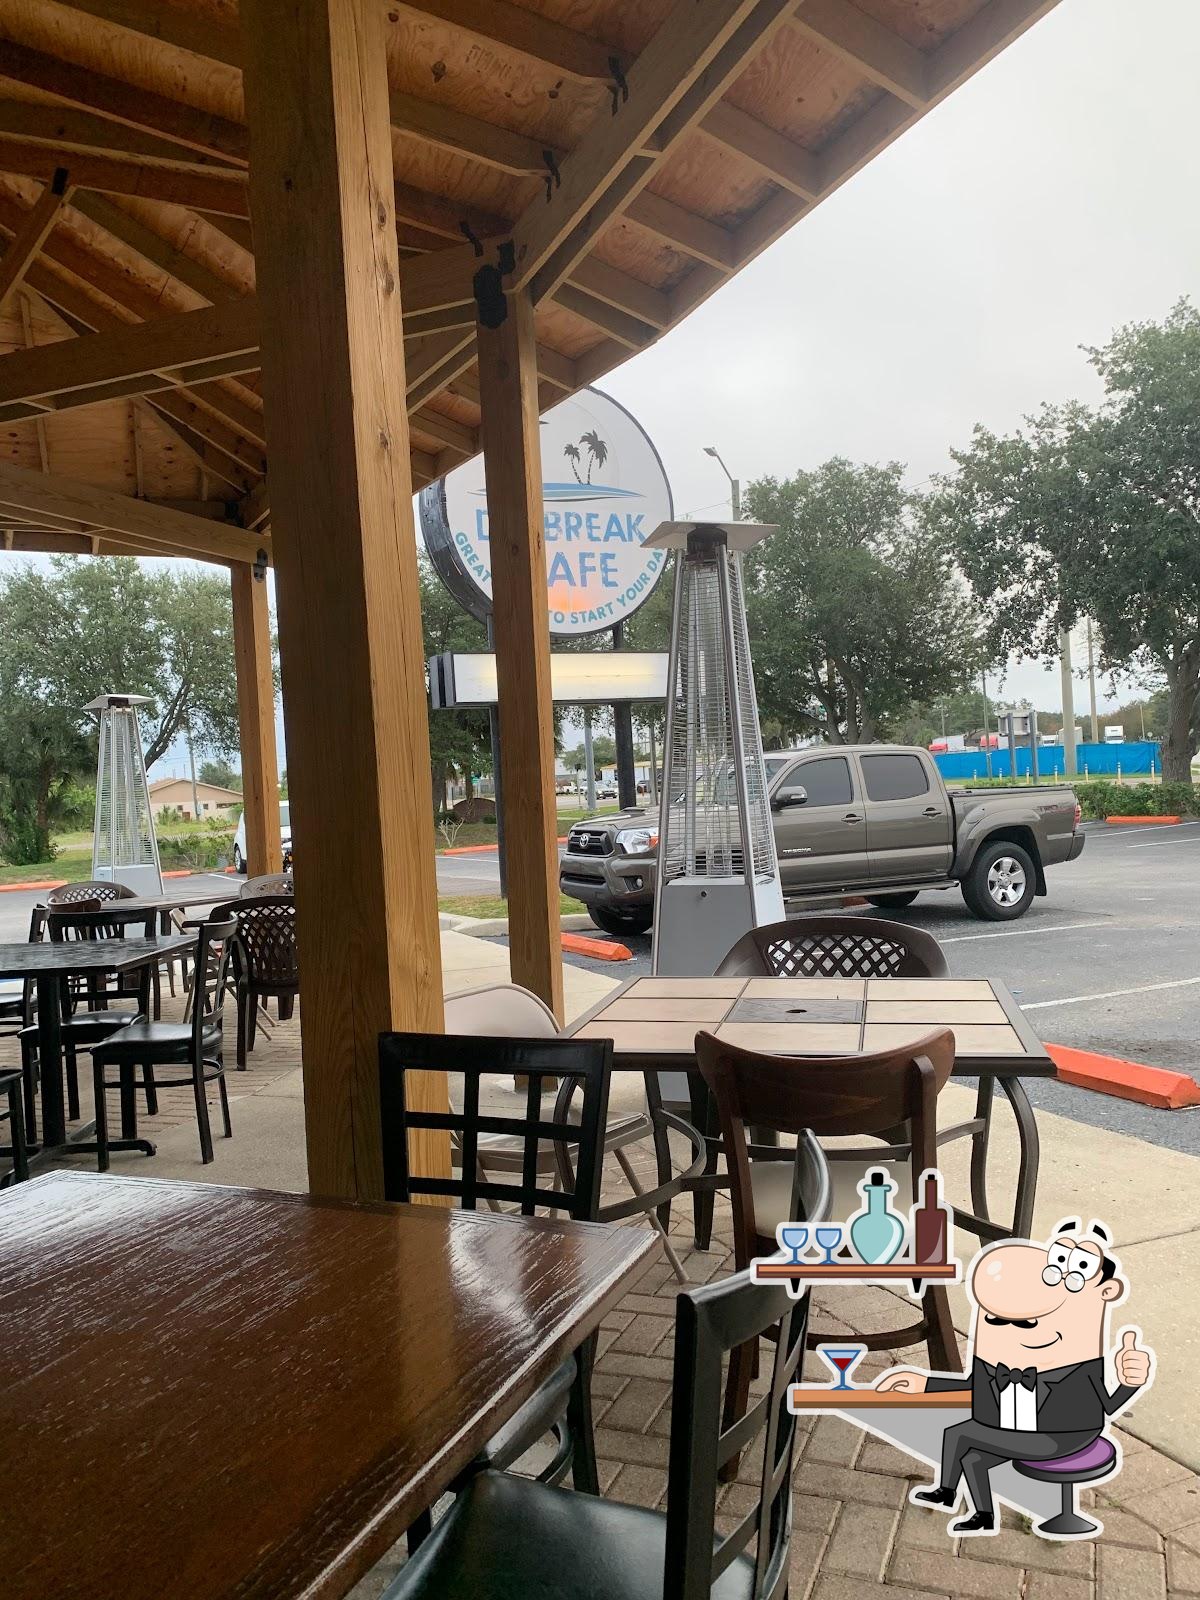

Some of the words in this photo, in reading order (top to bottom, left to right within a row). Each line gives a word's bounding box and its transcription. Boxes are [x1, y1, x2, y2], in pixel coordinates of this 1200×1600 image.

[476, 509, 647, 542] DBREAK
[548, 552, 618, 587] AFE
[570, 602, 614, 624] START
[616, 572, 651, 607] YOUR
[647, 549, 664, 573] DA
